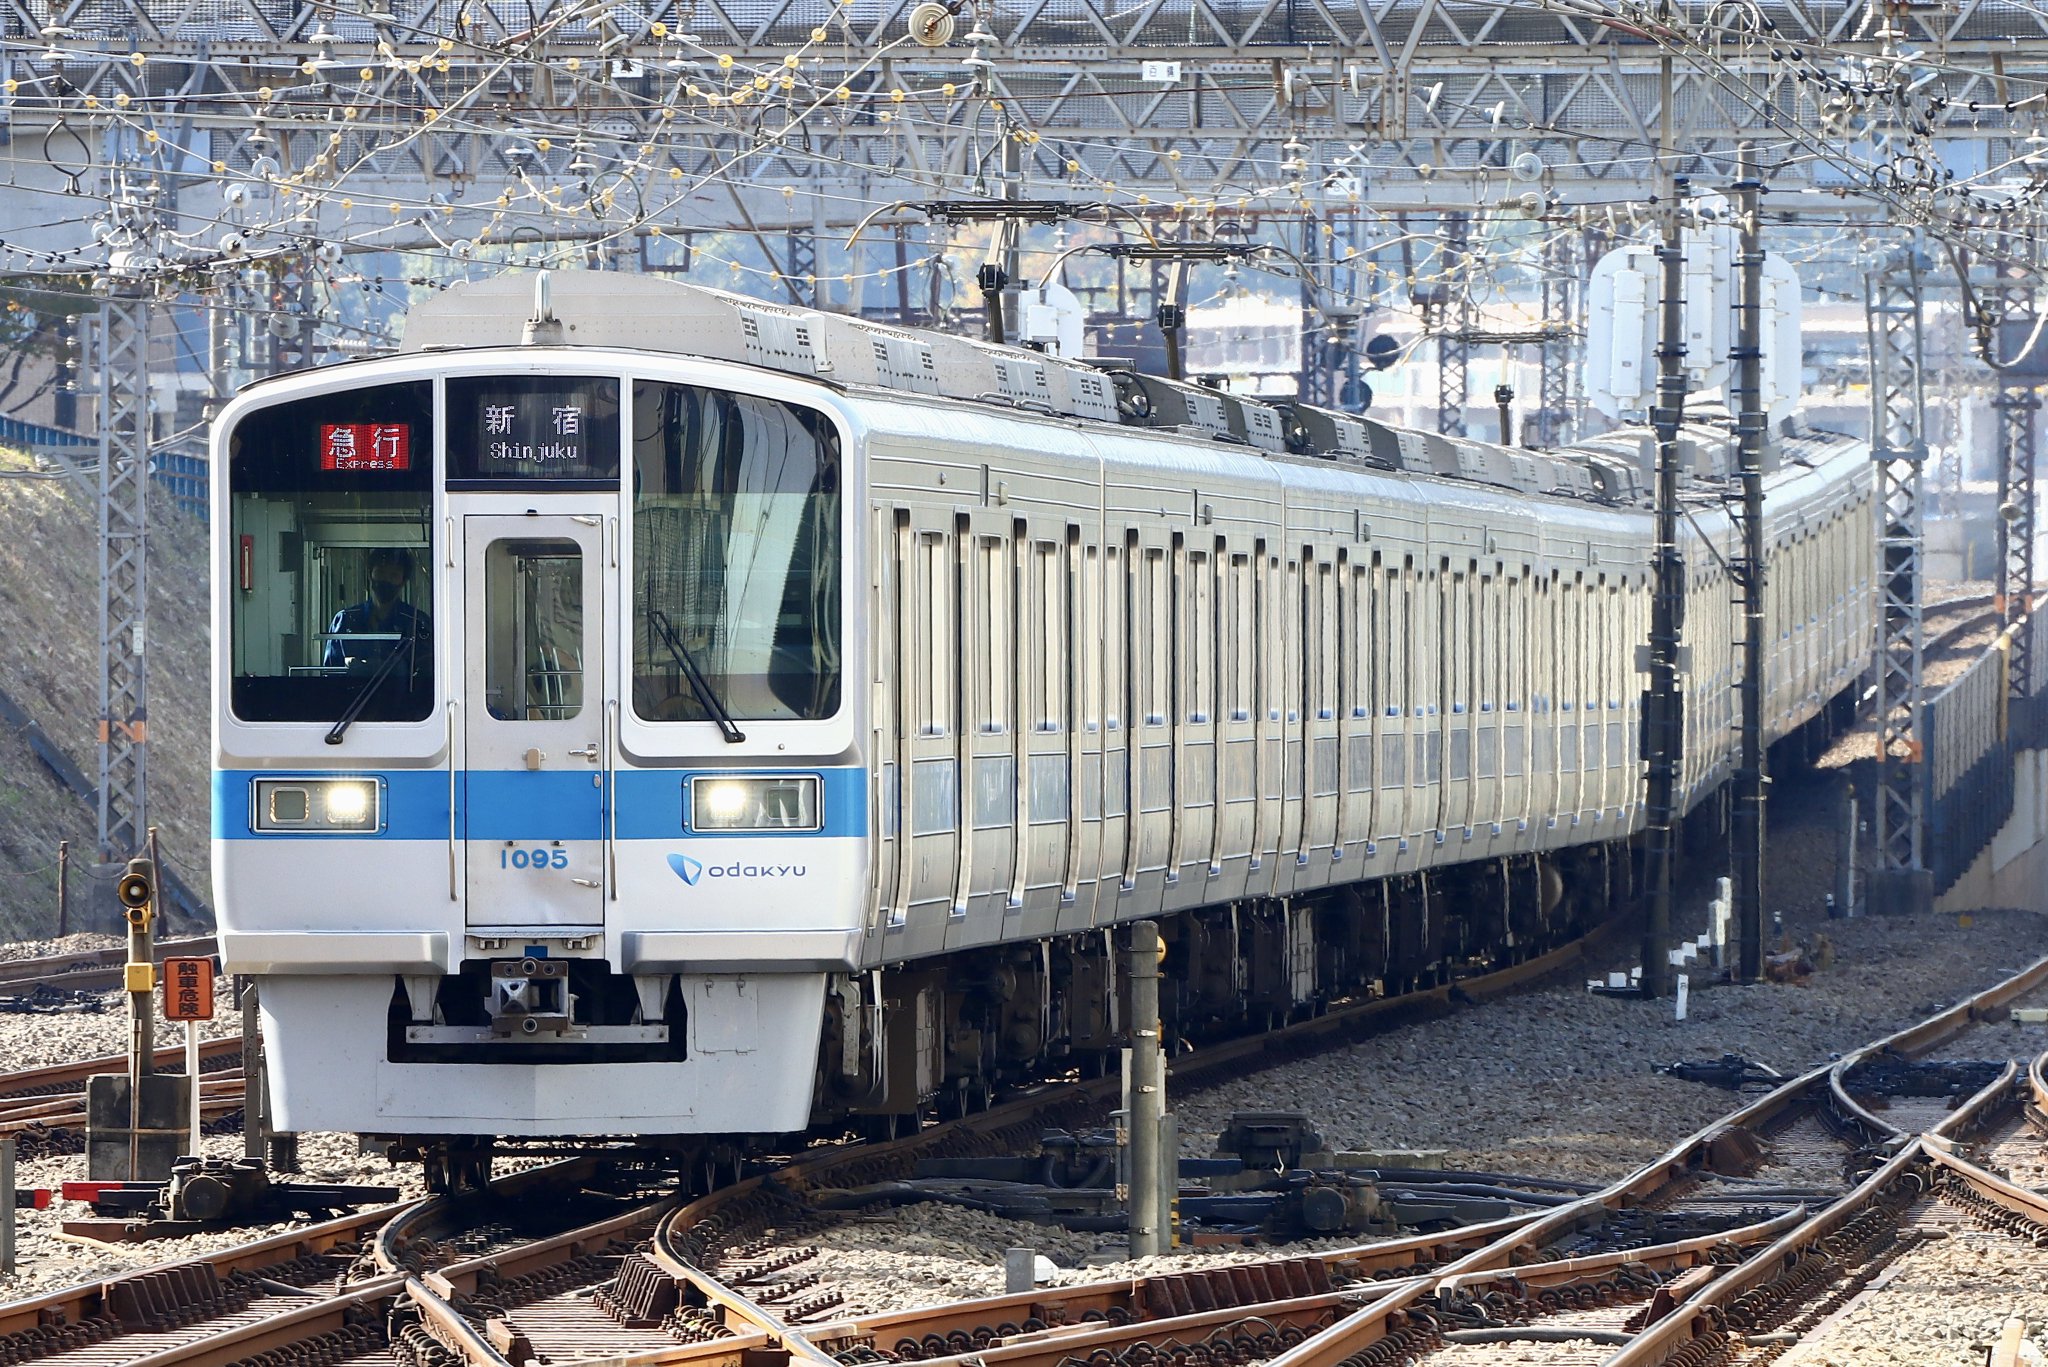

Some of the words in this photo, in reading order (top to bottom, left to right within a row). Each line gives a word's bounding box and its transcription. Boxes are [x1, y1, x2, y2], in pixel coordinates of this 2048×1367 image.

[485, 404, 581, 435] 新宿
[328, 427, 399, 457] 急行
[490, 442, 577, 463] Shinjuku
[336, 458, 394, 469] Express
[501, 848, 568, 869] 1095
[177, 962, 199, 1016] 触車危険
